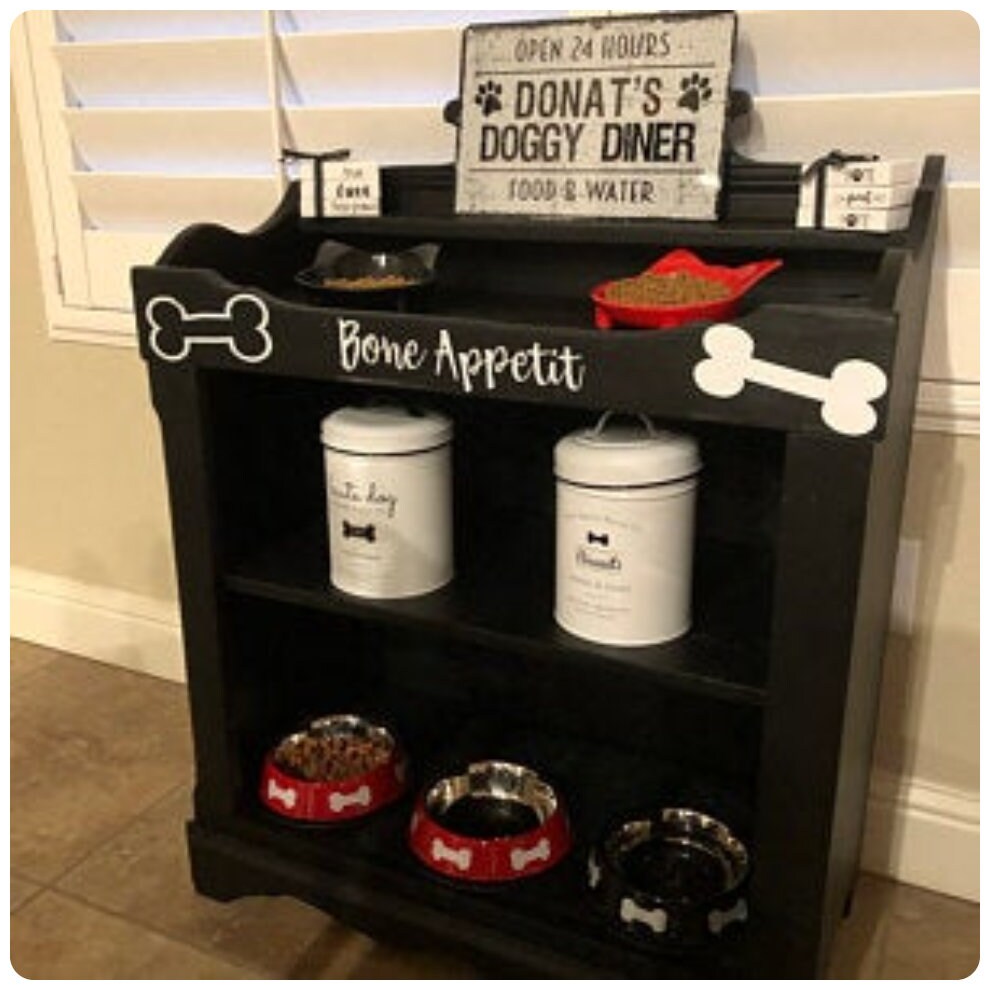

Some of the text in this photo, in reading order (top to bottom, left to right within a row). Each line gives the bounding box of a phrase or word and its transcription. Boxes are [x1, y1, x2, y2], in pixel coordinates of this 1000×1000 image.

[514, 33, 670, 62] OPEN 24 HOURS
[515, 77, 663, 119] DONAT'S
[480, 122, 696, 163] DOGGY DINER
[510, 178, 557, 201] FOOD
[587, 180, 654, 203] WATER
[337, 316, 586, 392] Bone Appetit
